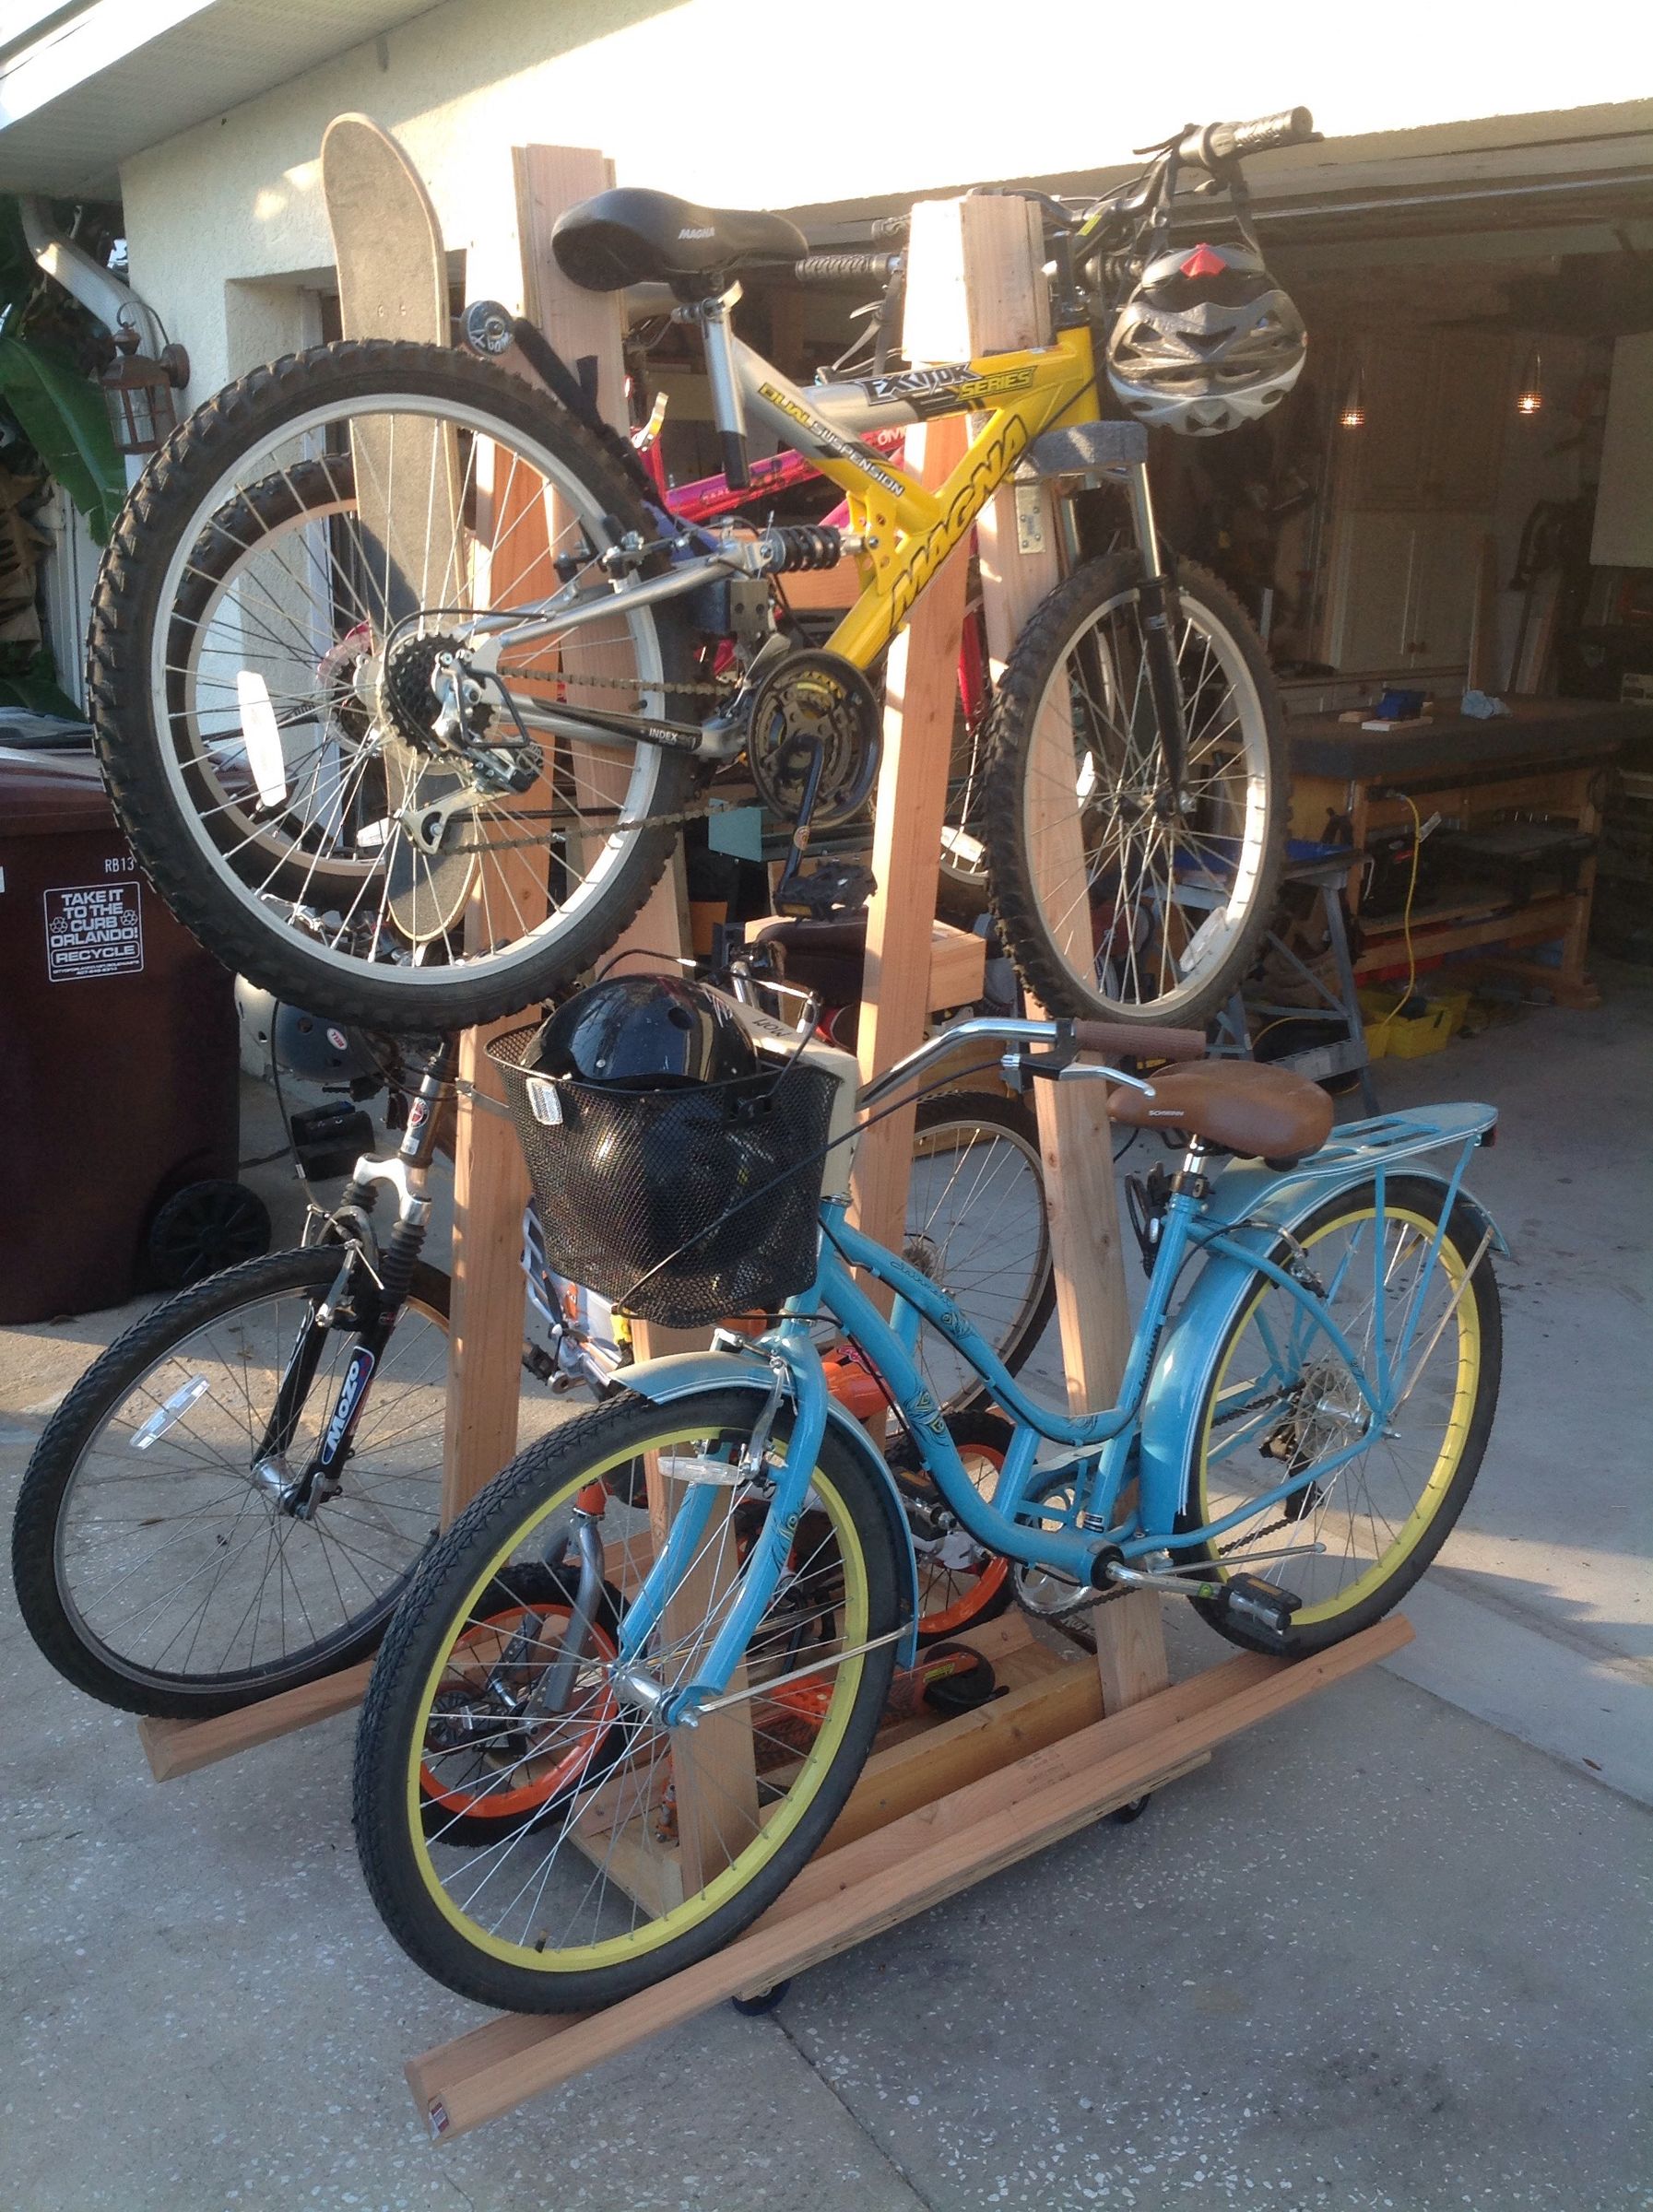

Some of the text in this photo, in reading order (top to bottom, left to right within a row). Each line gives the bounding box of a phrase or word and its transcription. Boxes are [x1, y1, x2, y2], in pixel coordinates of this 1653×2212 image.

[960, 370, 1033, 398] SERIES
[759, 382, 905, 498] DUAL SUSPENSION
[889, 414, 1028, 634] MAGNA
[649, 727, 679, 743] INDEX
[61, 888, 124, 906] TAKE IT
[63, 902, 124, 920] TO THE
[70, 916, 118, 933] CURB
[50, 927, 138, 947] ORLANDO!
[55, 945, 136, 963] RECYCLE
